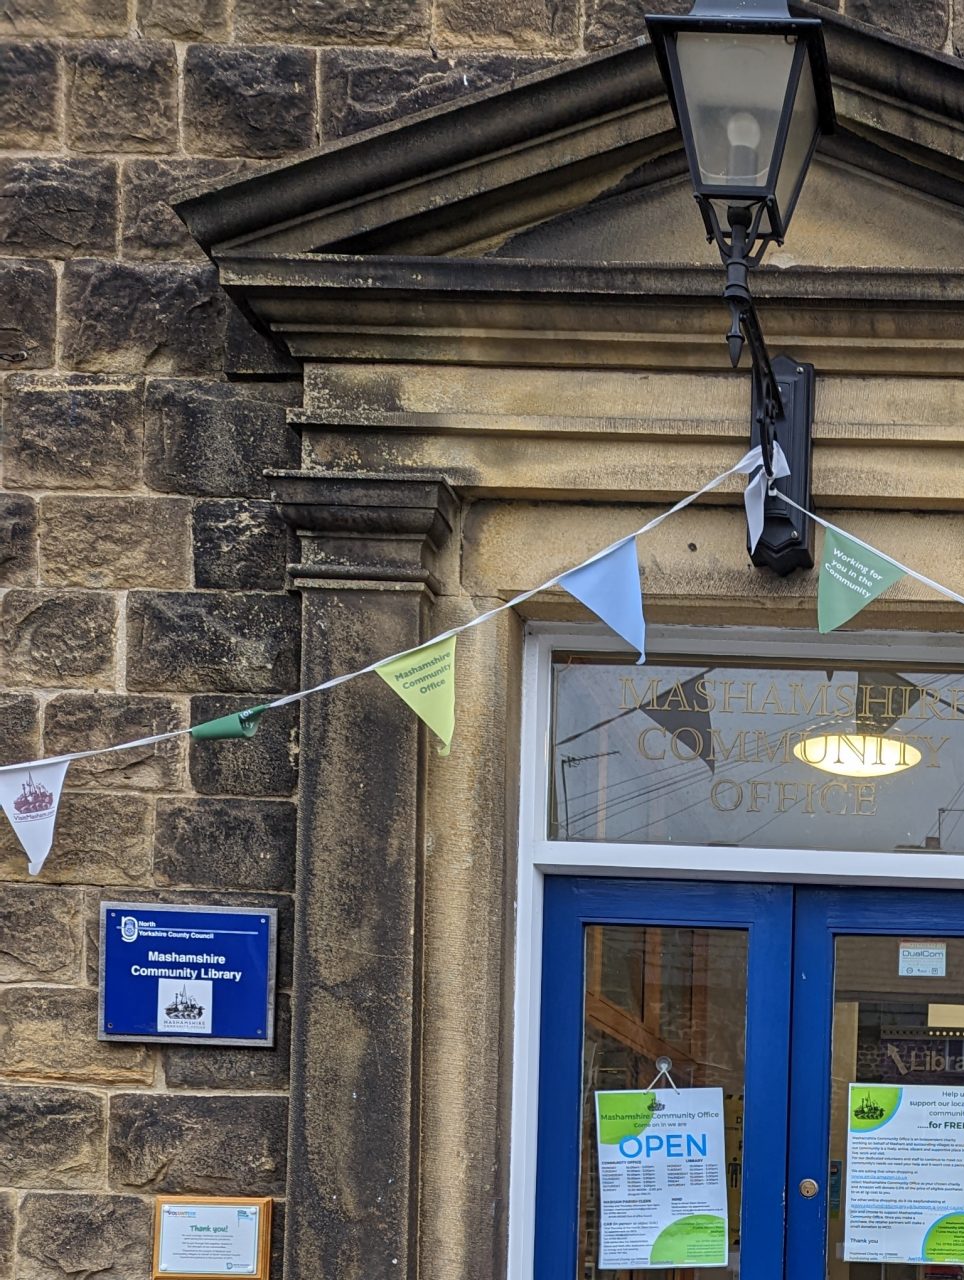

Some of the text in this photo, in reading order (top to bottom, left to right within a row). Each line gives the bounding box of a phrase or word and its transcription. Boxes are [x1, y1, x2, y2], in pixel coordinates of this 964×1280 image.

[833, 547, 884, 580] Working for
[824, 562, 872, 599] Community
[831, 559, 873, 587] you in the
[394, 651, 451, 682] Mashamshire
[401, 664, 451, 691] Community
[419, 677, 446, 695] Office
[637, 726, 953, 769] COMMUNITY
[709, 778, 879, 817] OFFICE
[138, 920, 156, 928] North
[138, 930, 214, 940] Yorkshire County Council
[148, 950, 226, 965] Mashamshire
[902, 950, 944, 958] DualCom
[130, 965, 242, 982] Community Library
[942, 1090, 959, 1099] Help
[909, 1100, 937, 1108] support
[600, 1111, 720, 1122] Mashamshire Community Office
[619, 1133, 708, 1159] OPEN
[212, 1225, 229, 1234] you!
